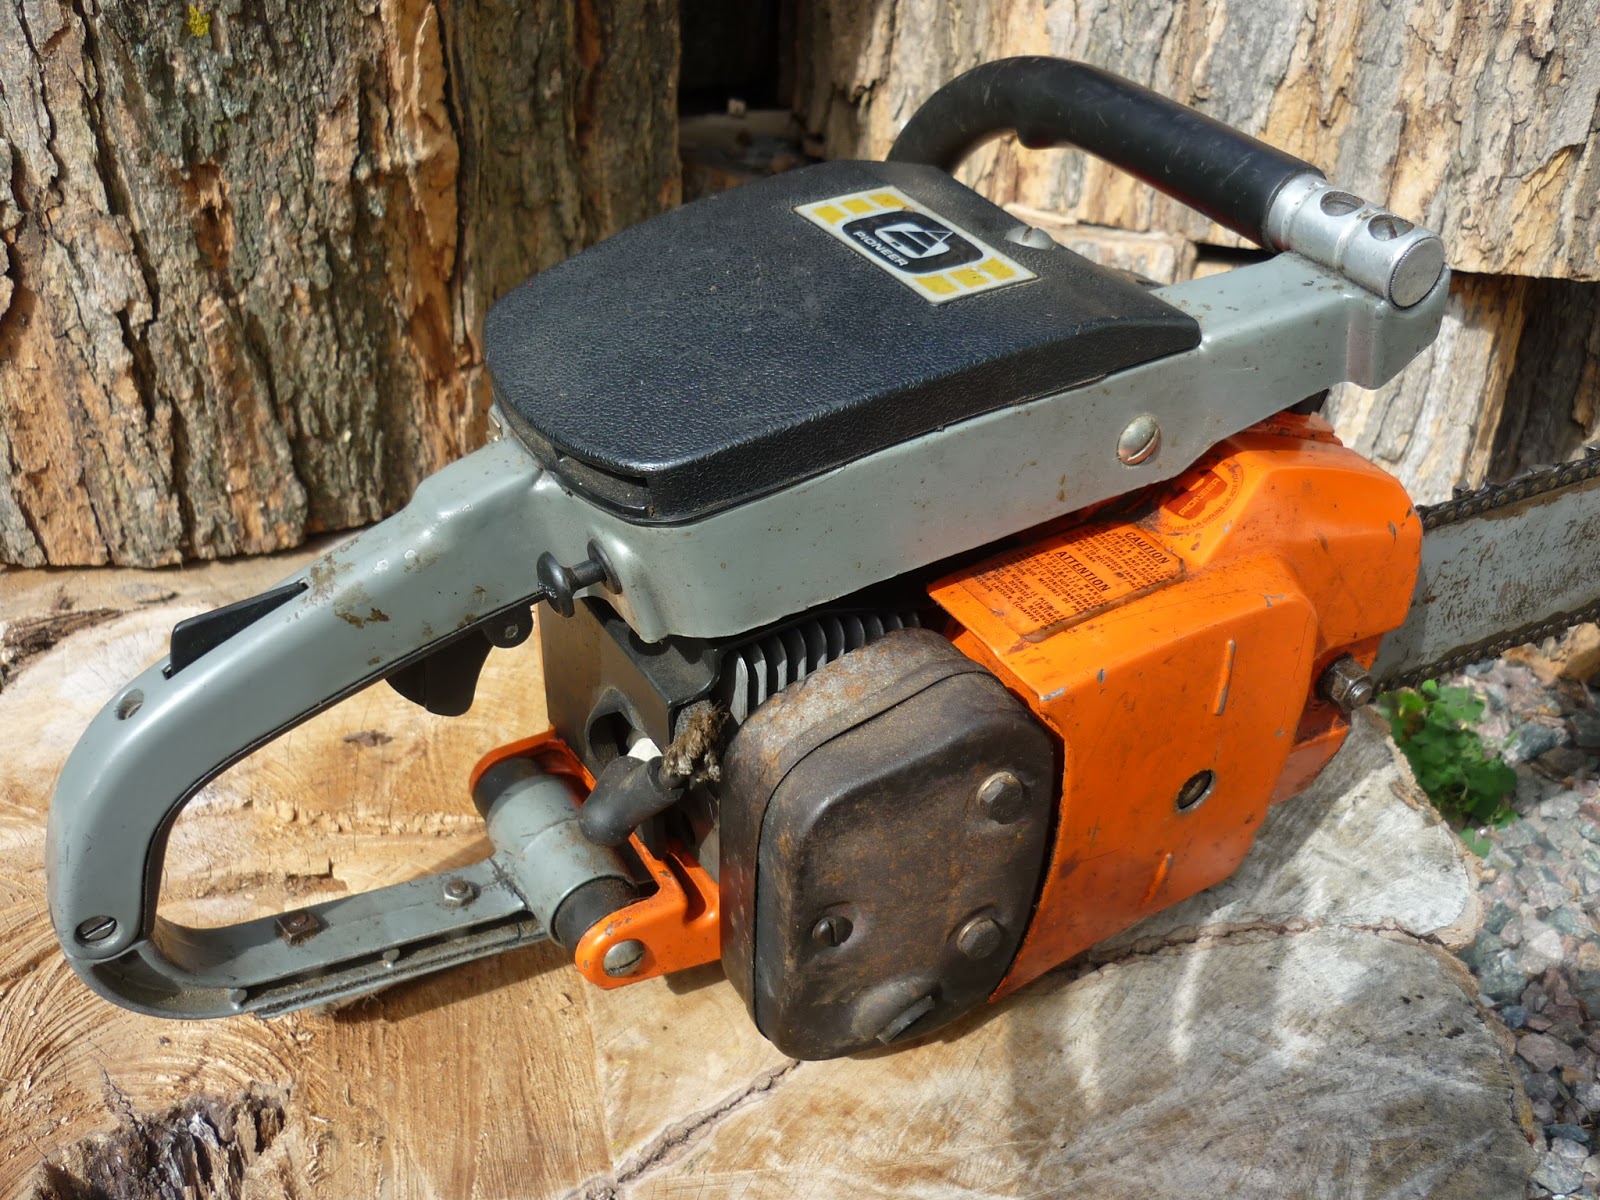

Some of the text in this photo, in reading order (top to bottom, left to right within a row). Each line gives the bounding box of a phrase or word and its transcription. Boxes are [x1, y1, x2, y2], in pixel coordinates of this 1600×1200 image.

[853, 231, 909, 267] PIONEER
[1178, 477, 1221, 516] PIONEER
[1102, 545, 1122, 559] SAFETY
[1123, 531, 1170, 564] CAUTION
[1055, 550, 1111, 591] ATTENTION
[1093, 555, 1116, 571] RELEASE
[1101, 554, 1123, 569] LOOSEN
[1121, 569, 1137, 580] TANK
[1126, 557, 1140, 566] AND
[1136, 551, 1161, 569] MANUAL
[989, 574, 1017, 594] BOUCHON
[1023, 567, 1037, 576] QUE
[1035, 577, 1062, 596] MESURES
[1056, 578, 1070, 587] SUR
